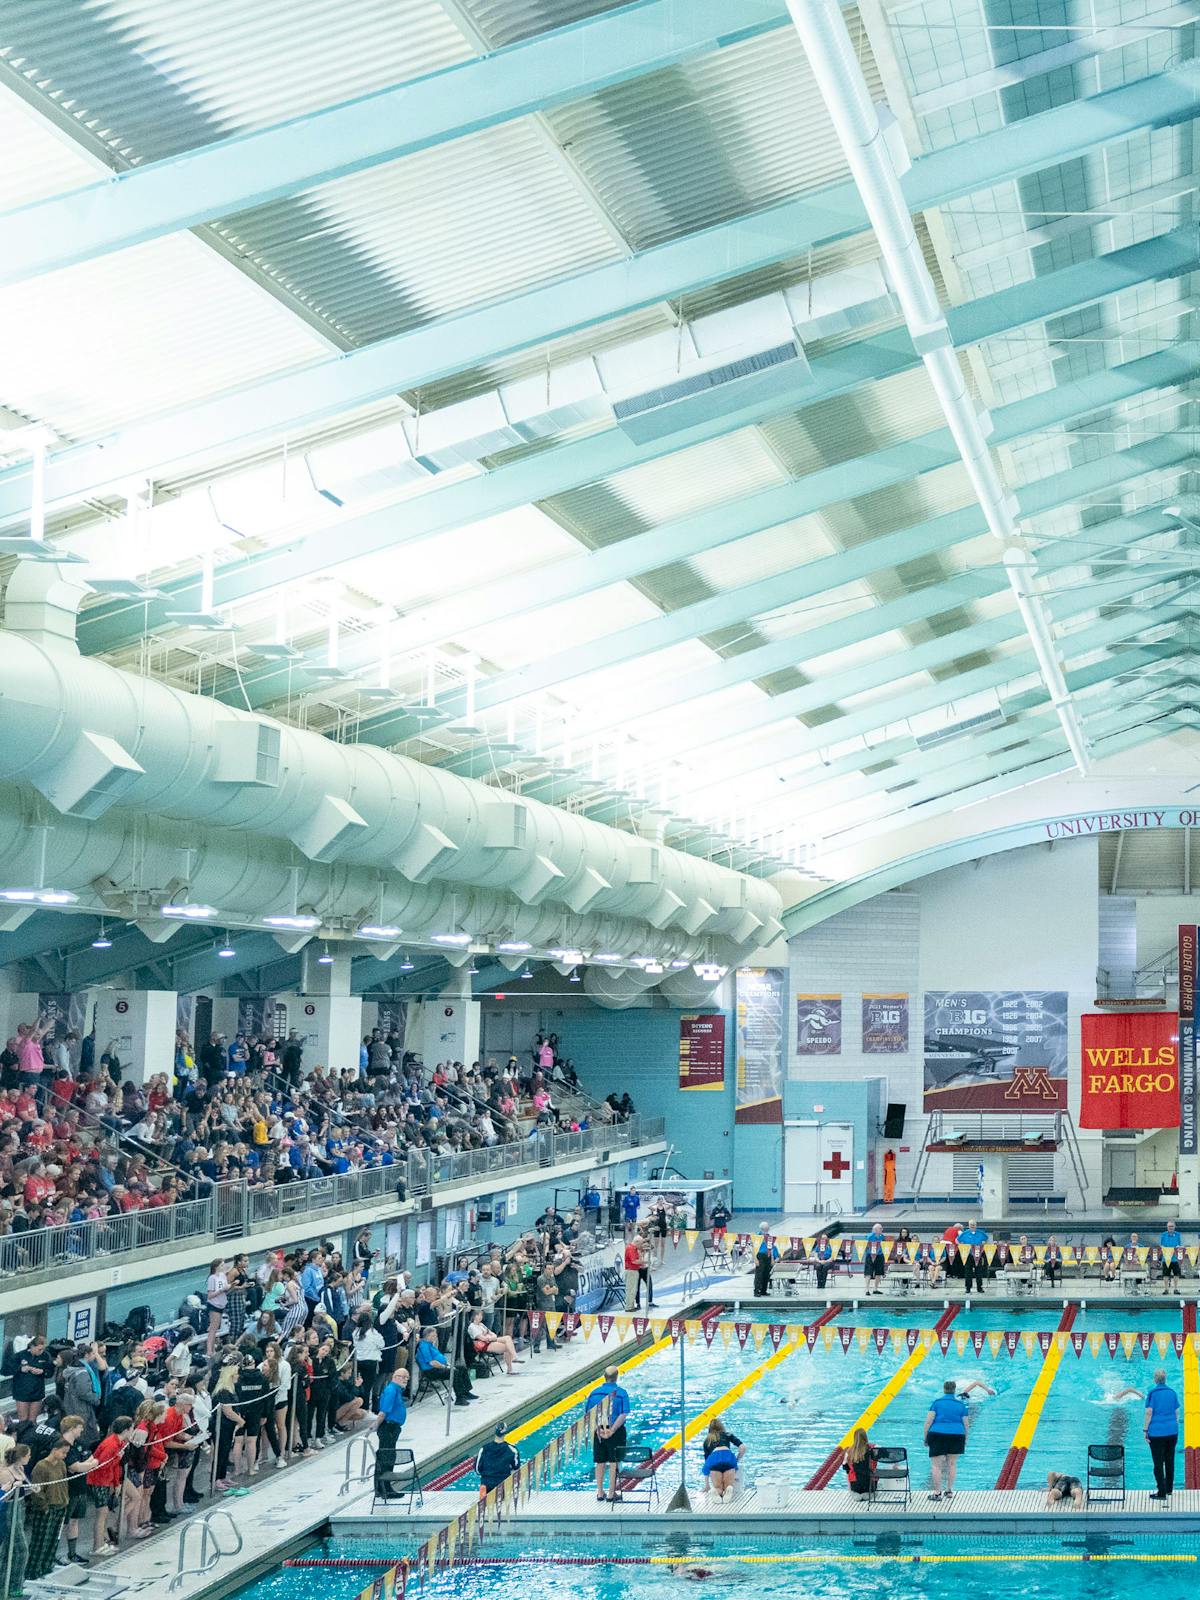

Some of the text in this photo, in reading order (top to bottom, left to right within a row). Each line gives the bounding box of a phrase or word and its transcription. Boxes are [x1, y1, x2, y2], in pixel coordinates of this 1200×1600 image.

[1046, 811, 1165, 839] UNIVERSITY
[1182, 935, 1193, 1012] GOLDEN GOPHER
[935, 998, 968, 1008] MEN'S
[935, 1027, 993, 1036] CHAMPIONS
[1084, 1046, 1176, 1067] WELLS
[1087, 1073, 1176, 1094] FARGO
